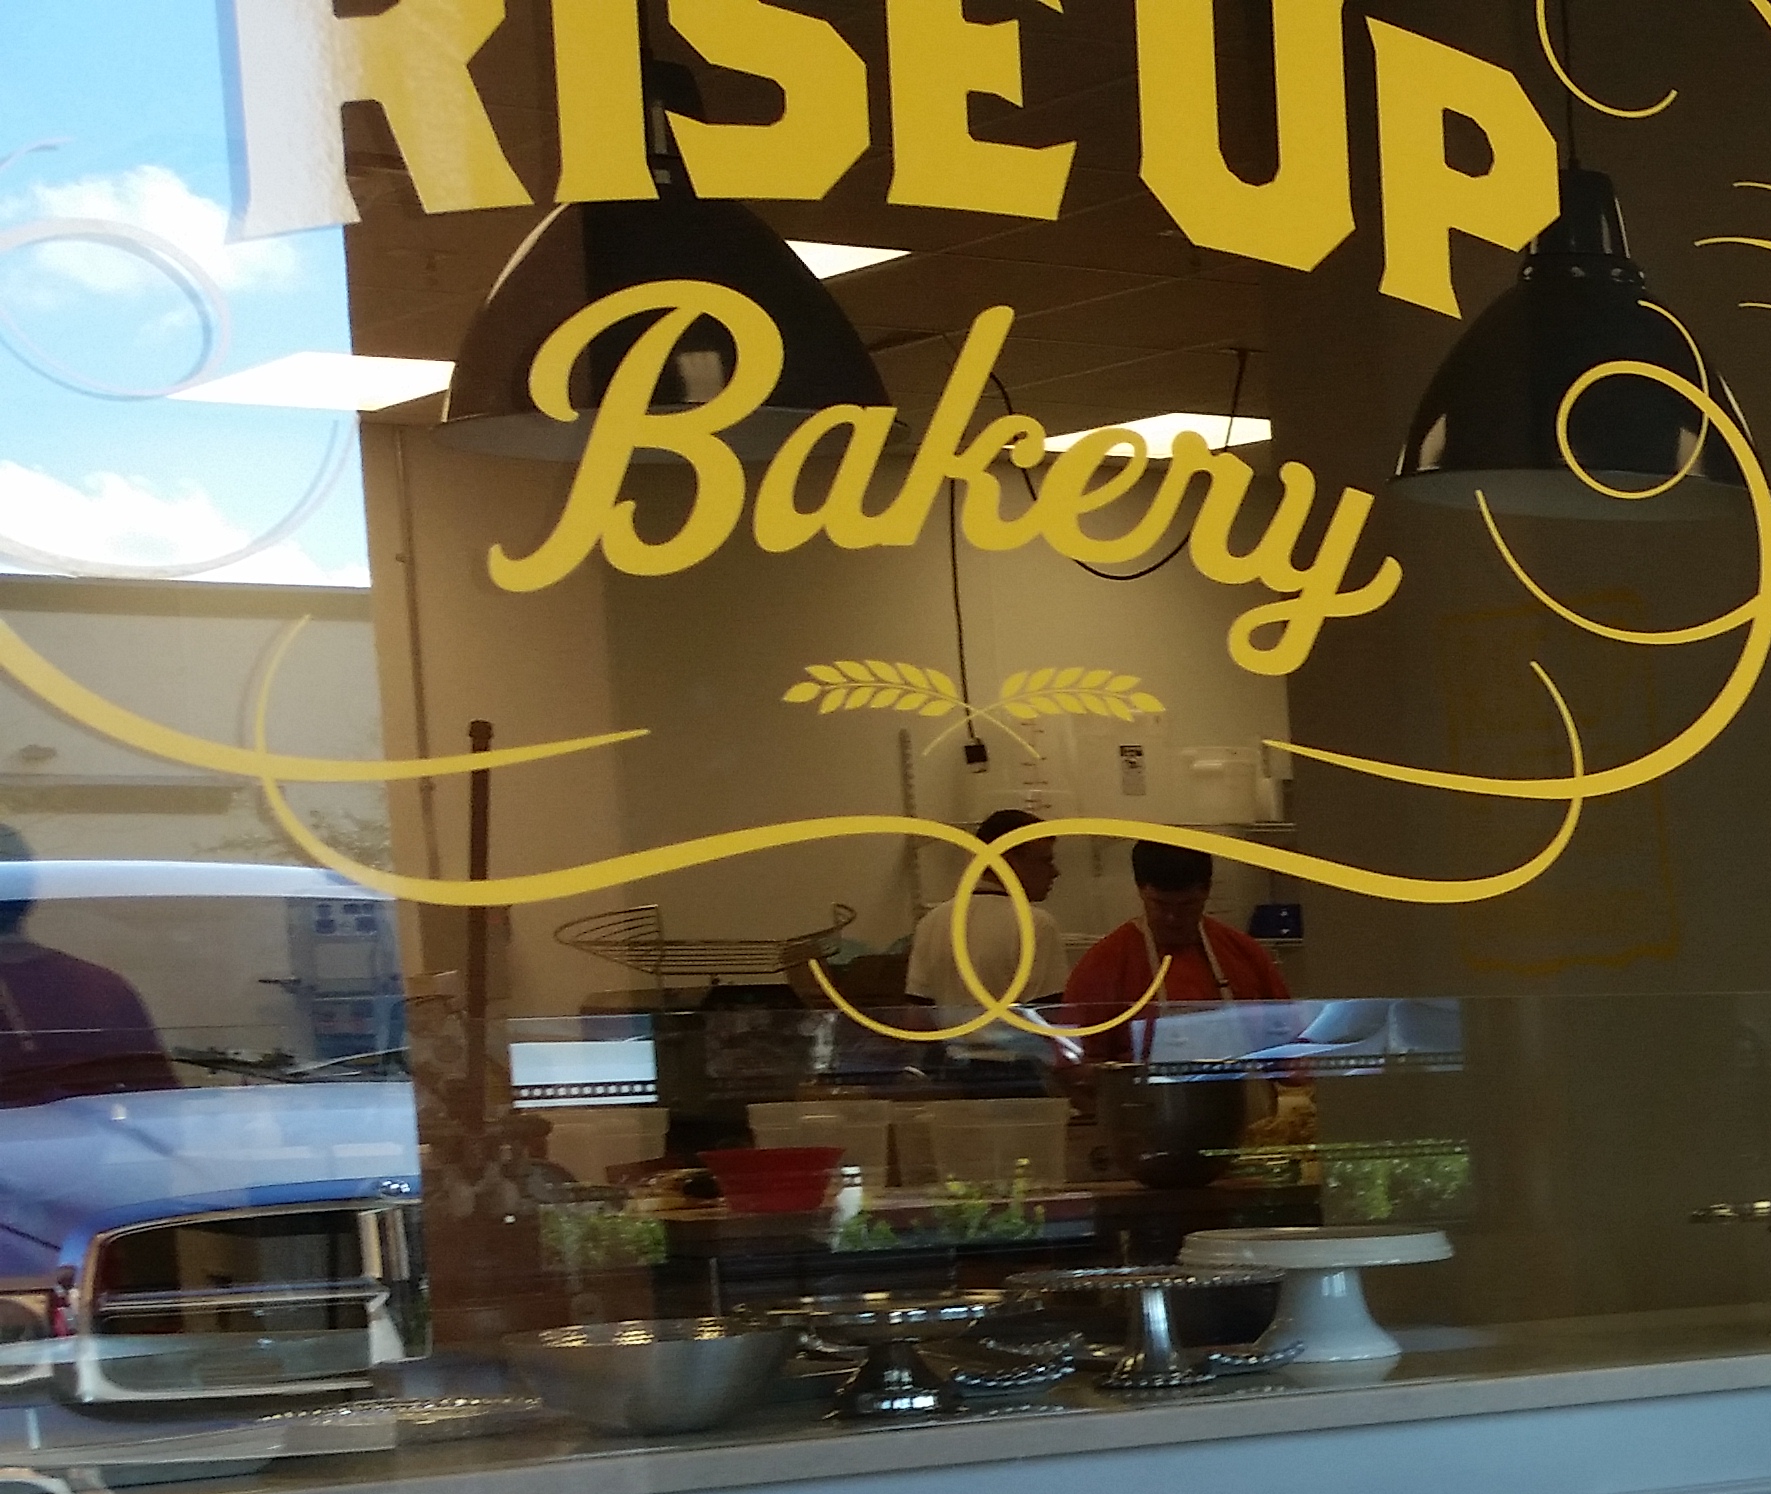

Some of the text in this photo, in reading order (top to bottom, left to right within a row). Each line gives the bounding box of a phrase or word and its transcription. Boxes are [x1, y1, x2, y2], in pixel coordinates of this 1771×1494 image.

[232, 0, 1561, 319] RISE UP
[487, 279, 1402, 676] Bakery
